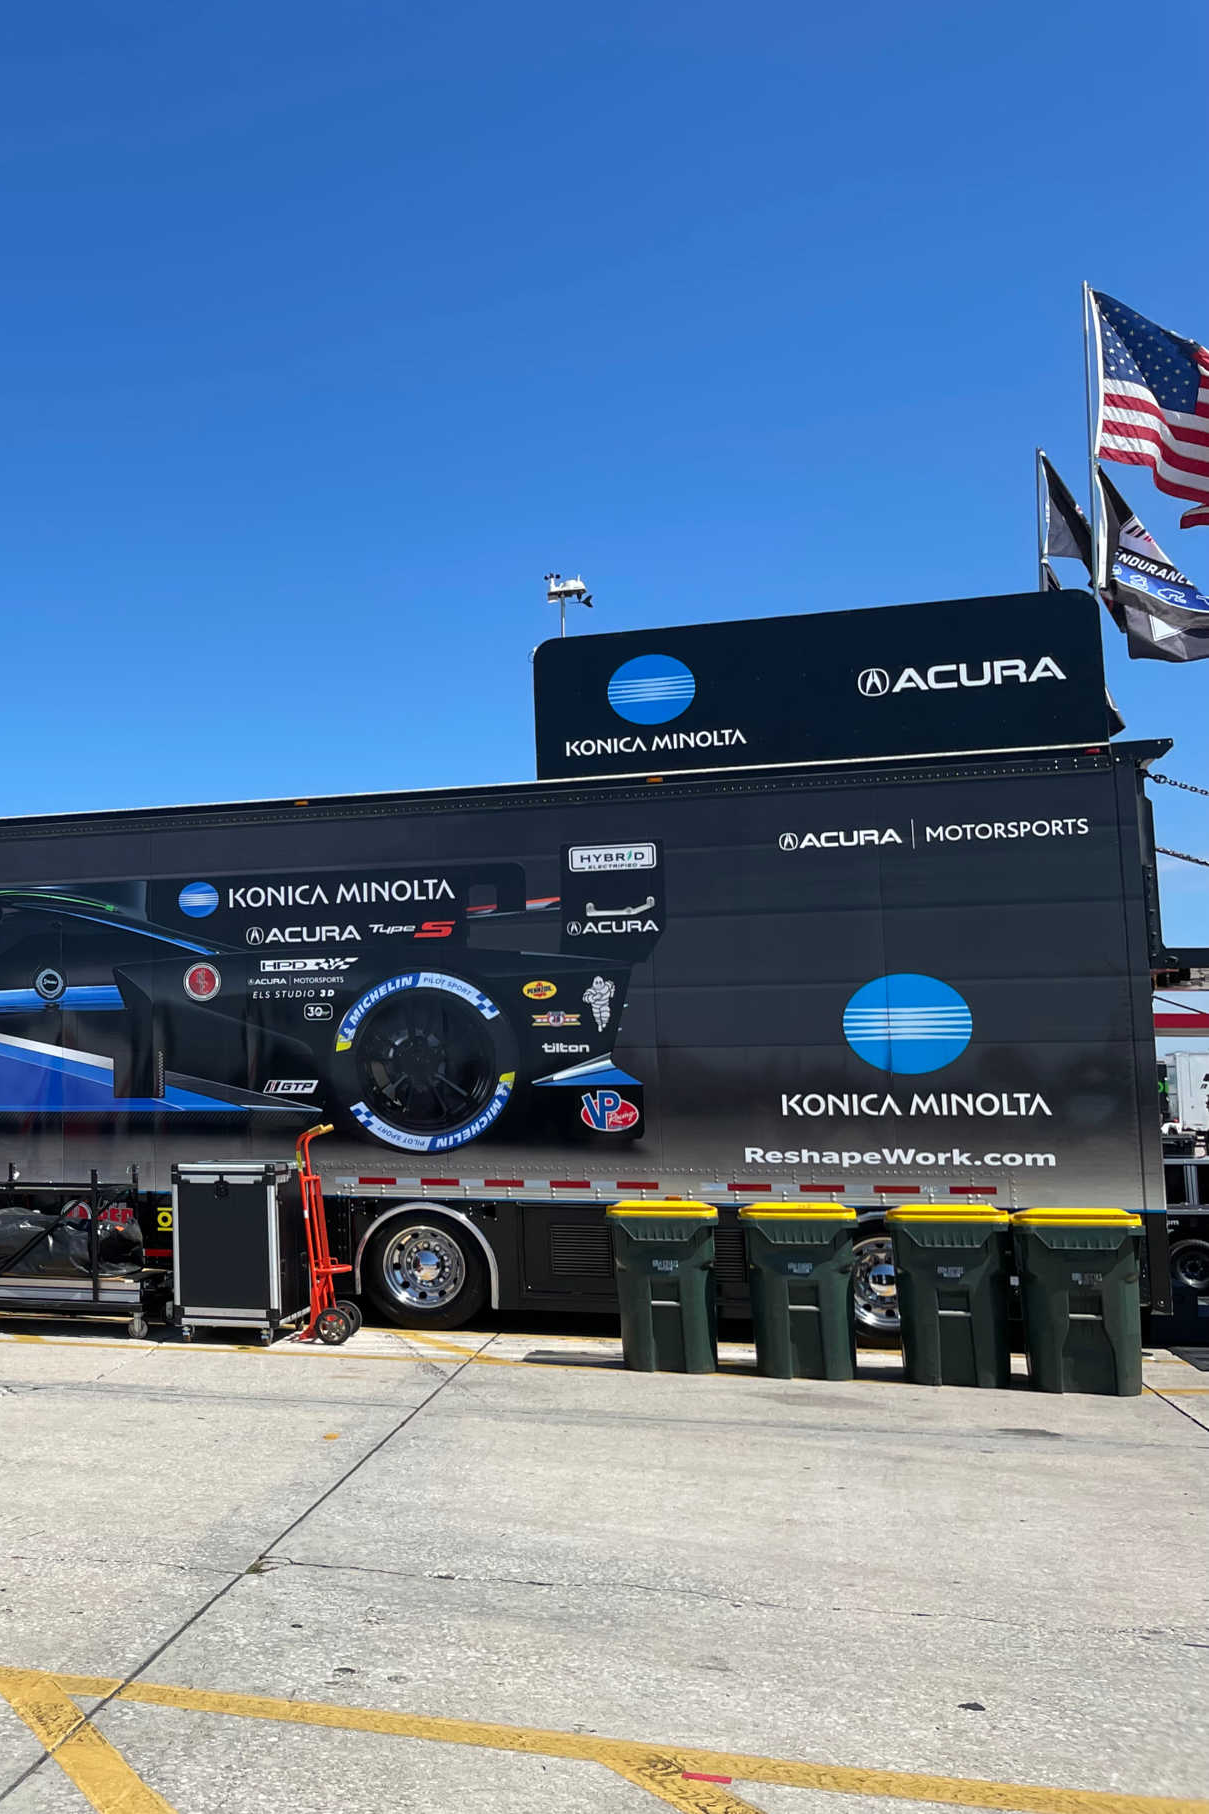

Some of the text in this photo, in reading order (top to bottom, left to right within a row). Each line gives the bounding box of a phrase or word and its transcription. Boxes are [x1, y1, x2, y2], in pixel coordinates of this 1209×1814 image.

[892, 656, 1067, 692] ACURA
[566, 728, 747, 757] KONICA MINOLTA
[799, 818, 1089, 848] ACURA MOTORSPORTS
[229, 879, 455, 908] KONICA MINOLTA
[265, 920, 456, 943] ACURA Type S
[582, 920, 659, 934] ACURA
[262, 960, 308, 971] HPD
[293, 976, 344, 984] MOTORSPORTS
[423, 976, 472, 997] PILOT SPORT
[252, 989, 335, 999] ELS STUDIO 3D
[350, 976, 414, 1026] MICHELIN
[542, 1043, 590, 1053] tilton
[281, 1082, 314, 1091] GTP
[581, 1090, 621, 1130] VP
[782, 1093, 1053, 1116] KONICA MINOLTA
[435, 1099, 503, 1148] MICHELIN
[744, 1147, 1057, 1168] ReshapeWork.com
